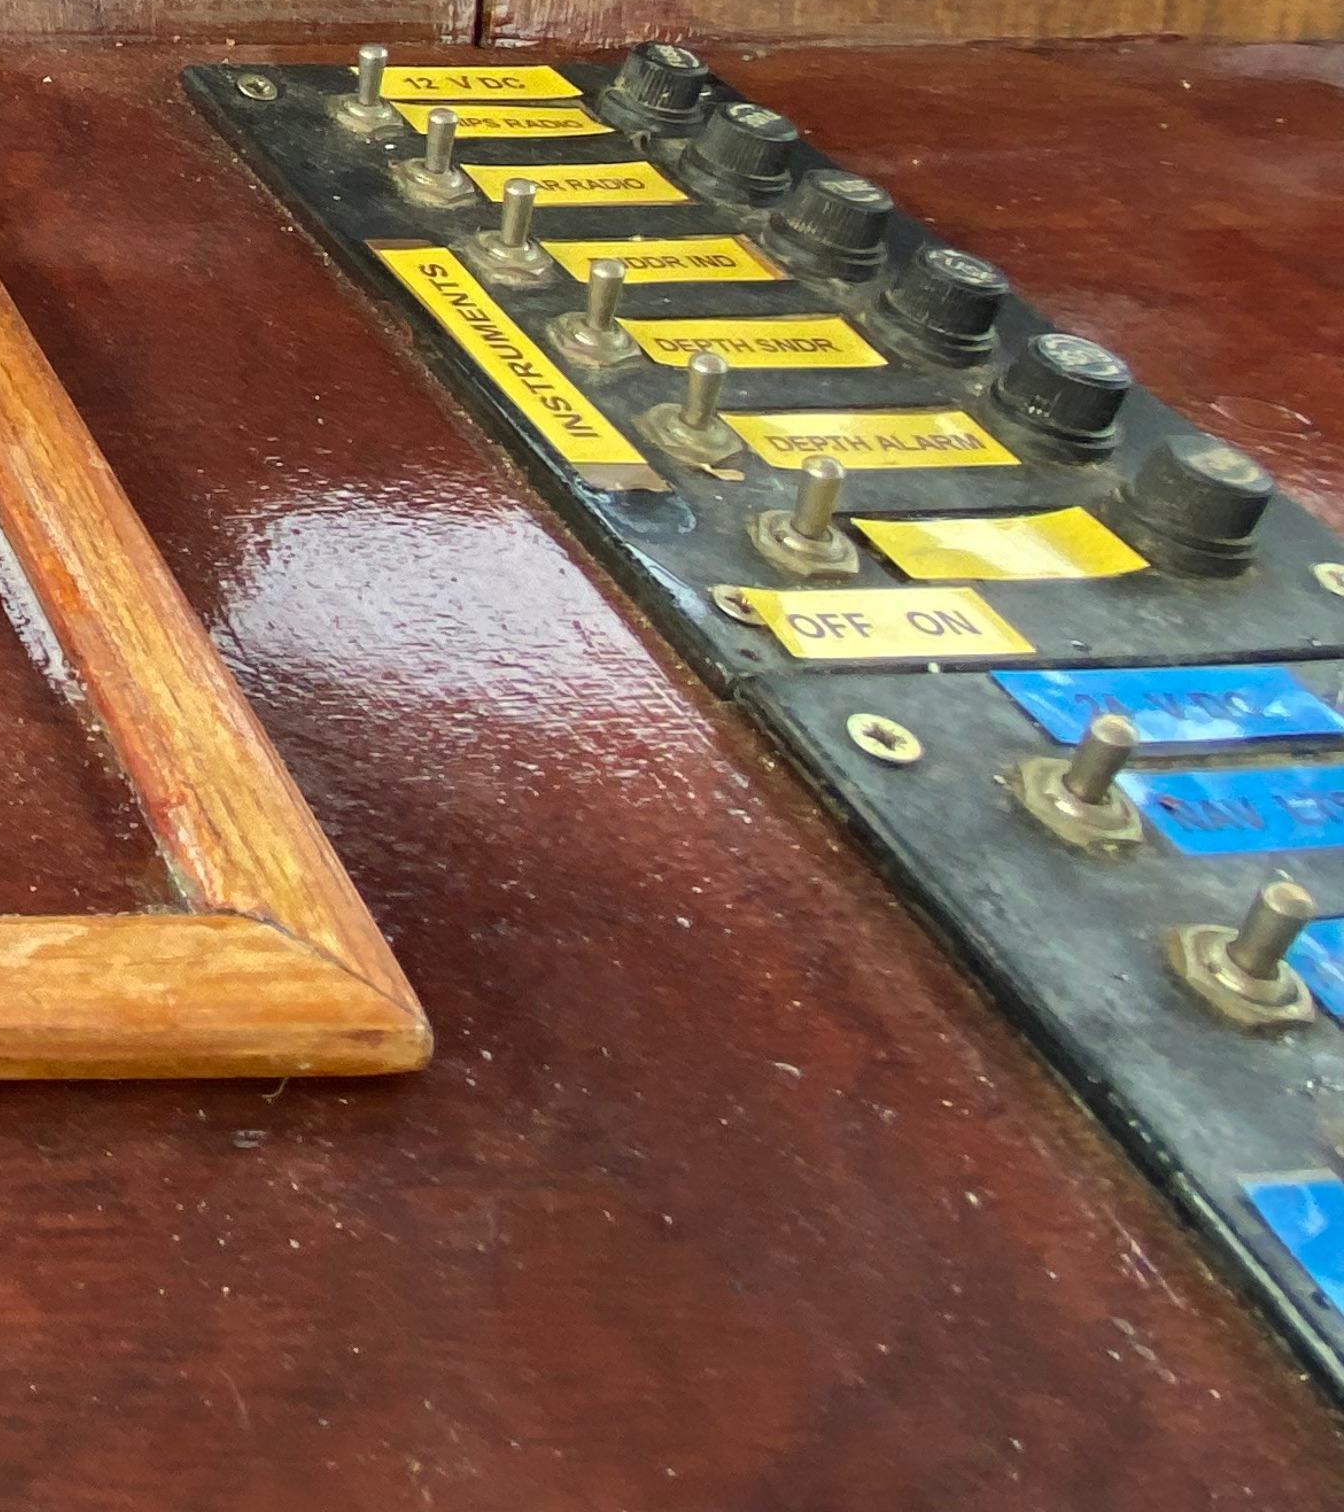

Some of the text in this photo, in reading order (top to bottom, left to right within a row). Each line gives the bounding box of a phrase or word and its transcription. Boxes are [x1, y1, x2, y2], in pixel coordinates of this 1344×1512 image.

[403, 76, 525, 90] 12 V DC
[503, 118, 584, 129] RADIO
[529, 178, 645, 191] AR RADIO
[688, 254, 737, 268] IND
[419, 263, 601, 439] INSTRUMENTS
[655, 338, 842, 353] DEPTH SNDR
[763, 433, 987, 452] DEPTH ALARM
[786, 609, 983, 638] OFF ON
